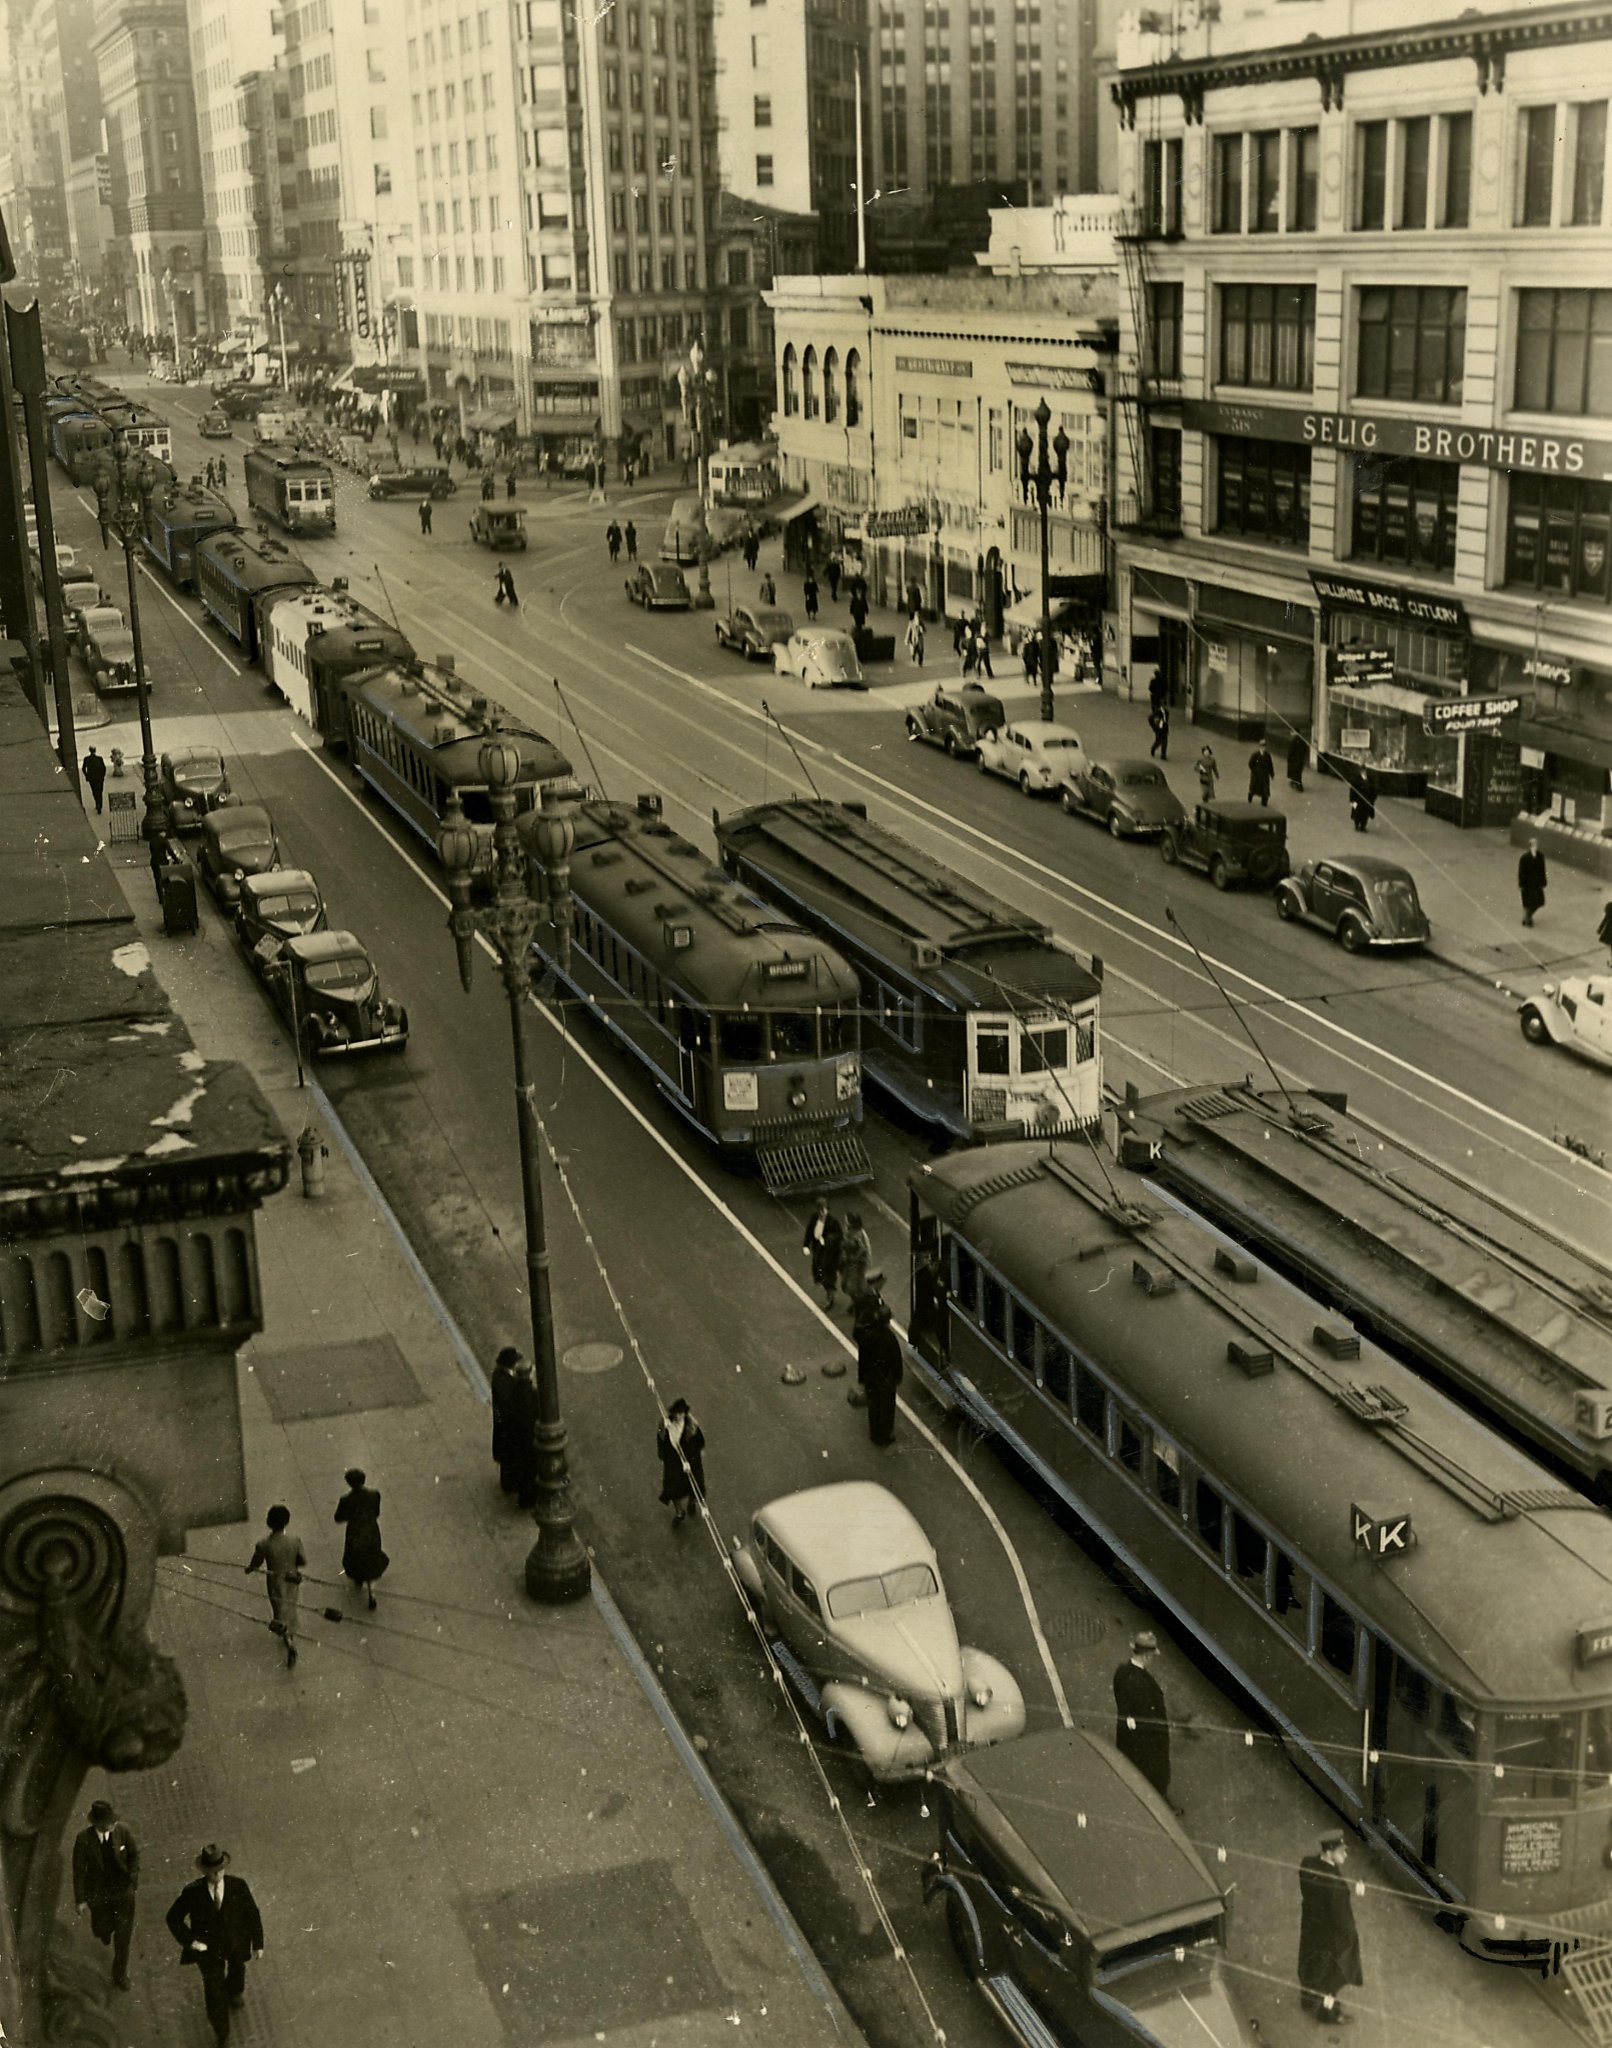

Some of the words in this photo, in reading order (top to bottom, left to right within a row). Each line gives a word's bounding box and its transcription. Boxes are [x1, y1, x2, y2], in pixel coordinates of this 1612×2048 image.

[1303, 415, 1377, 447] SELIG
[1415, 426, 1584, 472] BROTHERS
[1314, 581, 1365, 604] WILLIAMS
[1407, 600, 1458, 624] CUTLERY
[1435, 703, 1482, 720] COFFEE
[1485, 699, 1519, 715] SHOP
[1150, 1140, 1162, 1160] K
[1355, 1513, 1372, 1551] K
[1379, 1520, 1407, 1553] K
[1593, 1635, 1612, 1651] FE
